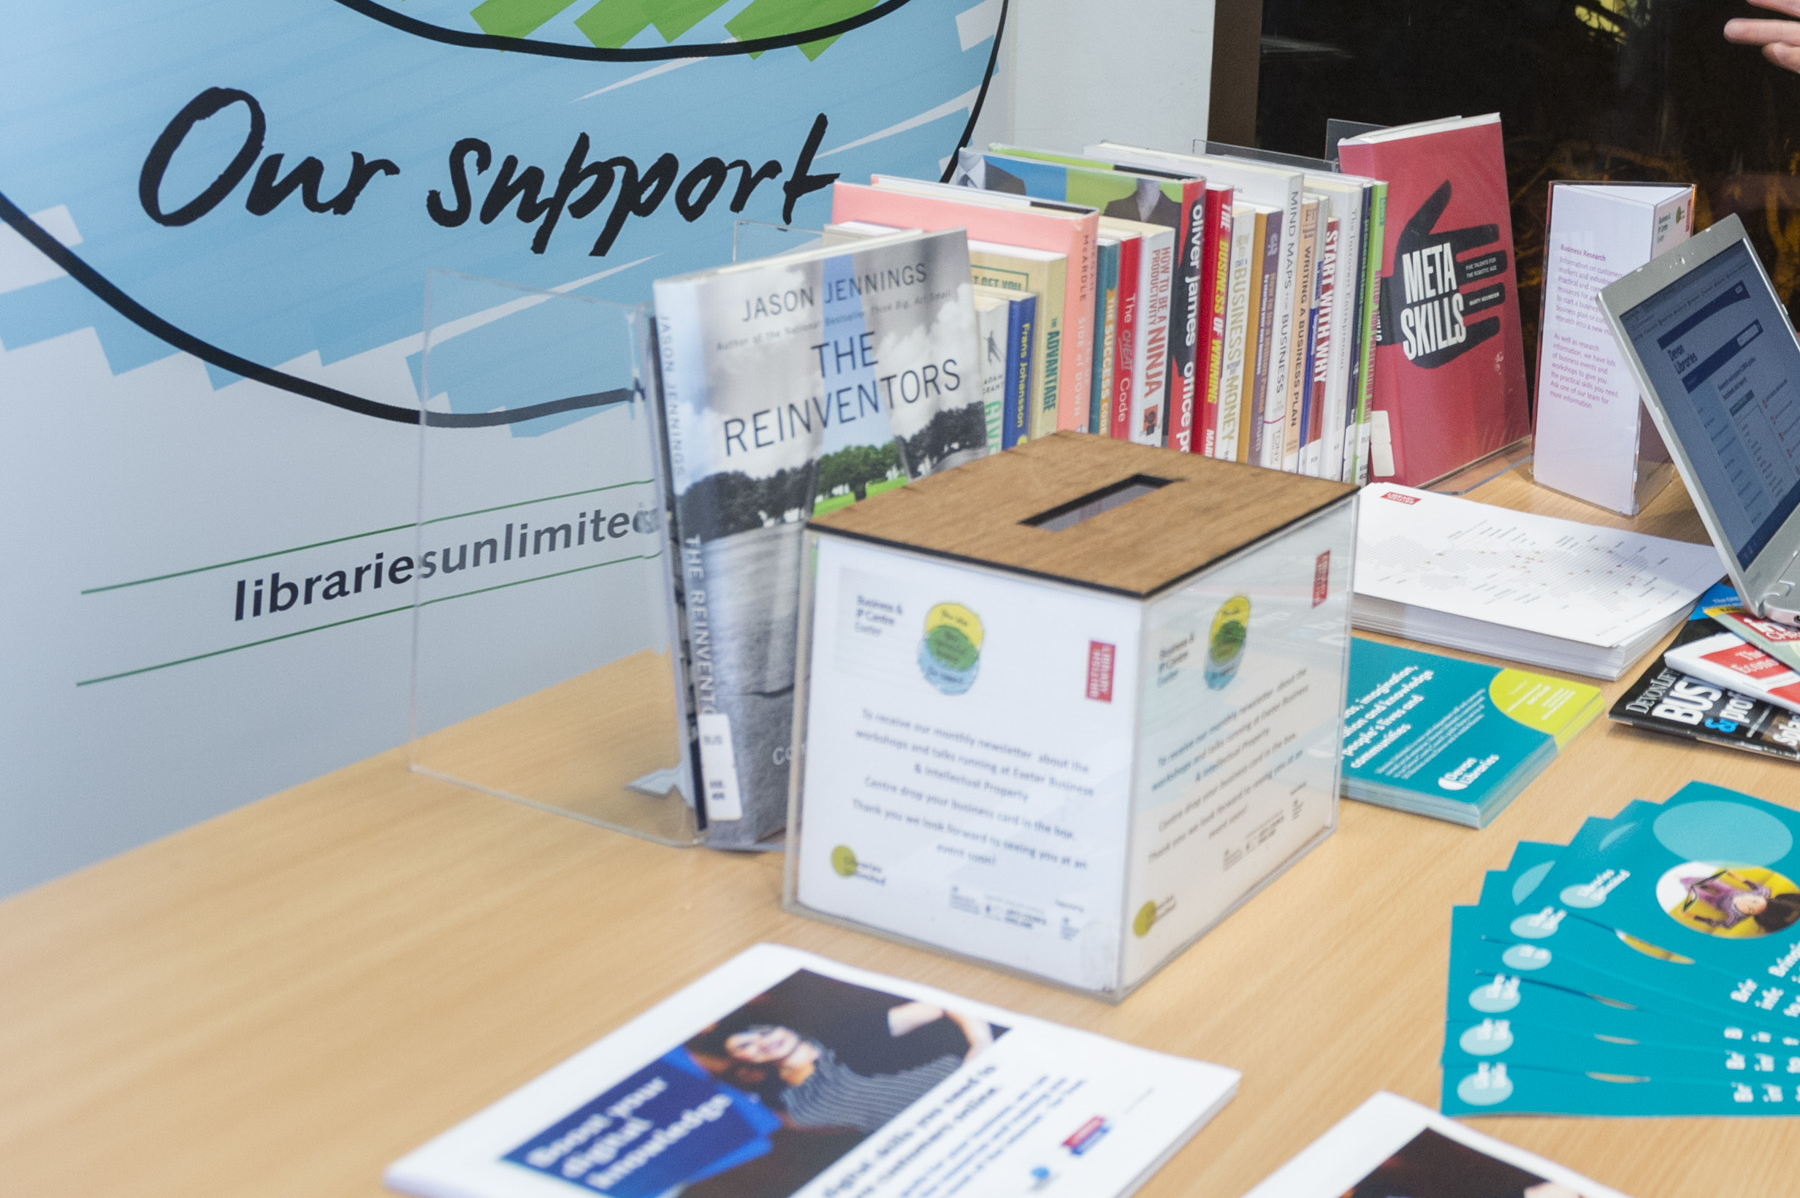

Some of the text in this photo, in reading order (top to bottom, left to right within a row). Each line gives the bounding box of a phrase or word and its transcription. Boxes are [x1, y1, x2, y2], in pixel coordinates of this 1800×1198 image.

[139, 85, 840, 258] Our support
[1221, 203, 1231, 232] THE
[1288, 191, 1299, 237] MIND
[742, 263, 928, 322] JASON JENNINGS
[1148, 249, 1160, 325] PRODUCTIVITY
[1157, 246, 1171, 324] HOW TO BE A
[1215, 238, 1228, 314] BUSINESS
[1284, 242, 1295, 290] MAPS
[1402, 242, 1457, 304] META
[1107, 297, 1115, 323] THE
[1180, 204, 1203, 428] oliver james office
[1213, 316, 1223, 337] OF
[1227, 266, 1248, 362] BUSINESS
[1291, 245, 1312, 427] WRITING A BUSINESS PLAN
[1313, 230, 1338, 383] START WITH WHY
[1400, 292, 1466, 361] SKILLS
[811, 331, 879, 378] THE
[1017, 322, 1030, 428] Frans Johansson
[1043, 329, 1060, 413] ADVANTAGE
[1101, 324, 1115, 398] SUCCESS
[1117, 293, 1136, 423] The CHEAT Code
[1144, 326, 1166, 398] NINJA
[1208, 338, 1221, 404] WINNING
[1276, 314, 1289, 393] BUSINESS
[1667, 344, 1686, 362] Devon
[1673, 353, 1698, 375] Libraries
[724, 359, 961, 456] REINVENTORS
[1222, 375, 1239, 441] MONEY
[685, 534, 704, 580] THE
[1735, 650, 1766, 661] The
[1704, 717, 1739, 733] &
[1443, 756, 1478, 781] Devon
[1457, 753, 1500, 786] Libraries
